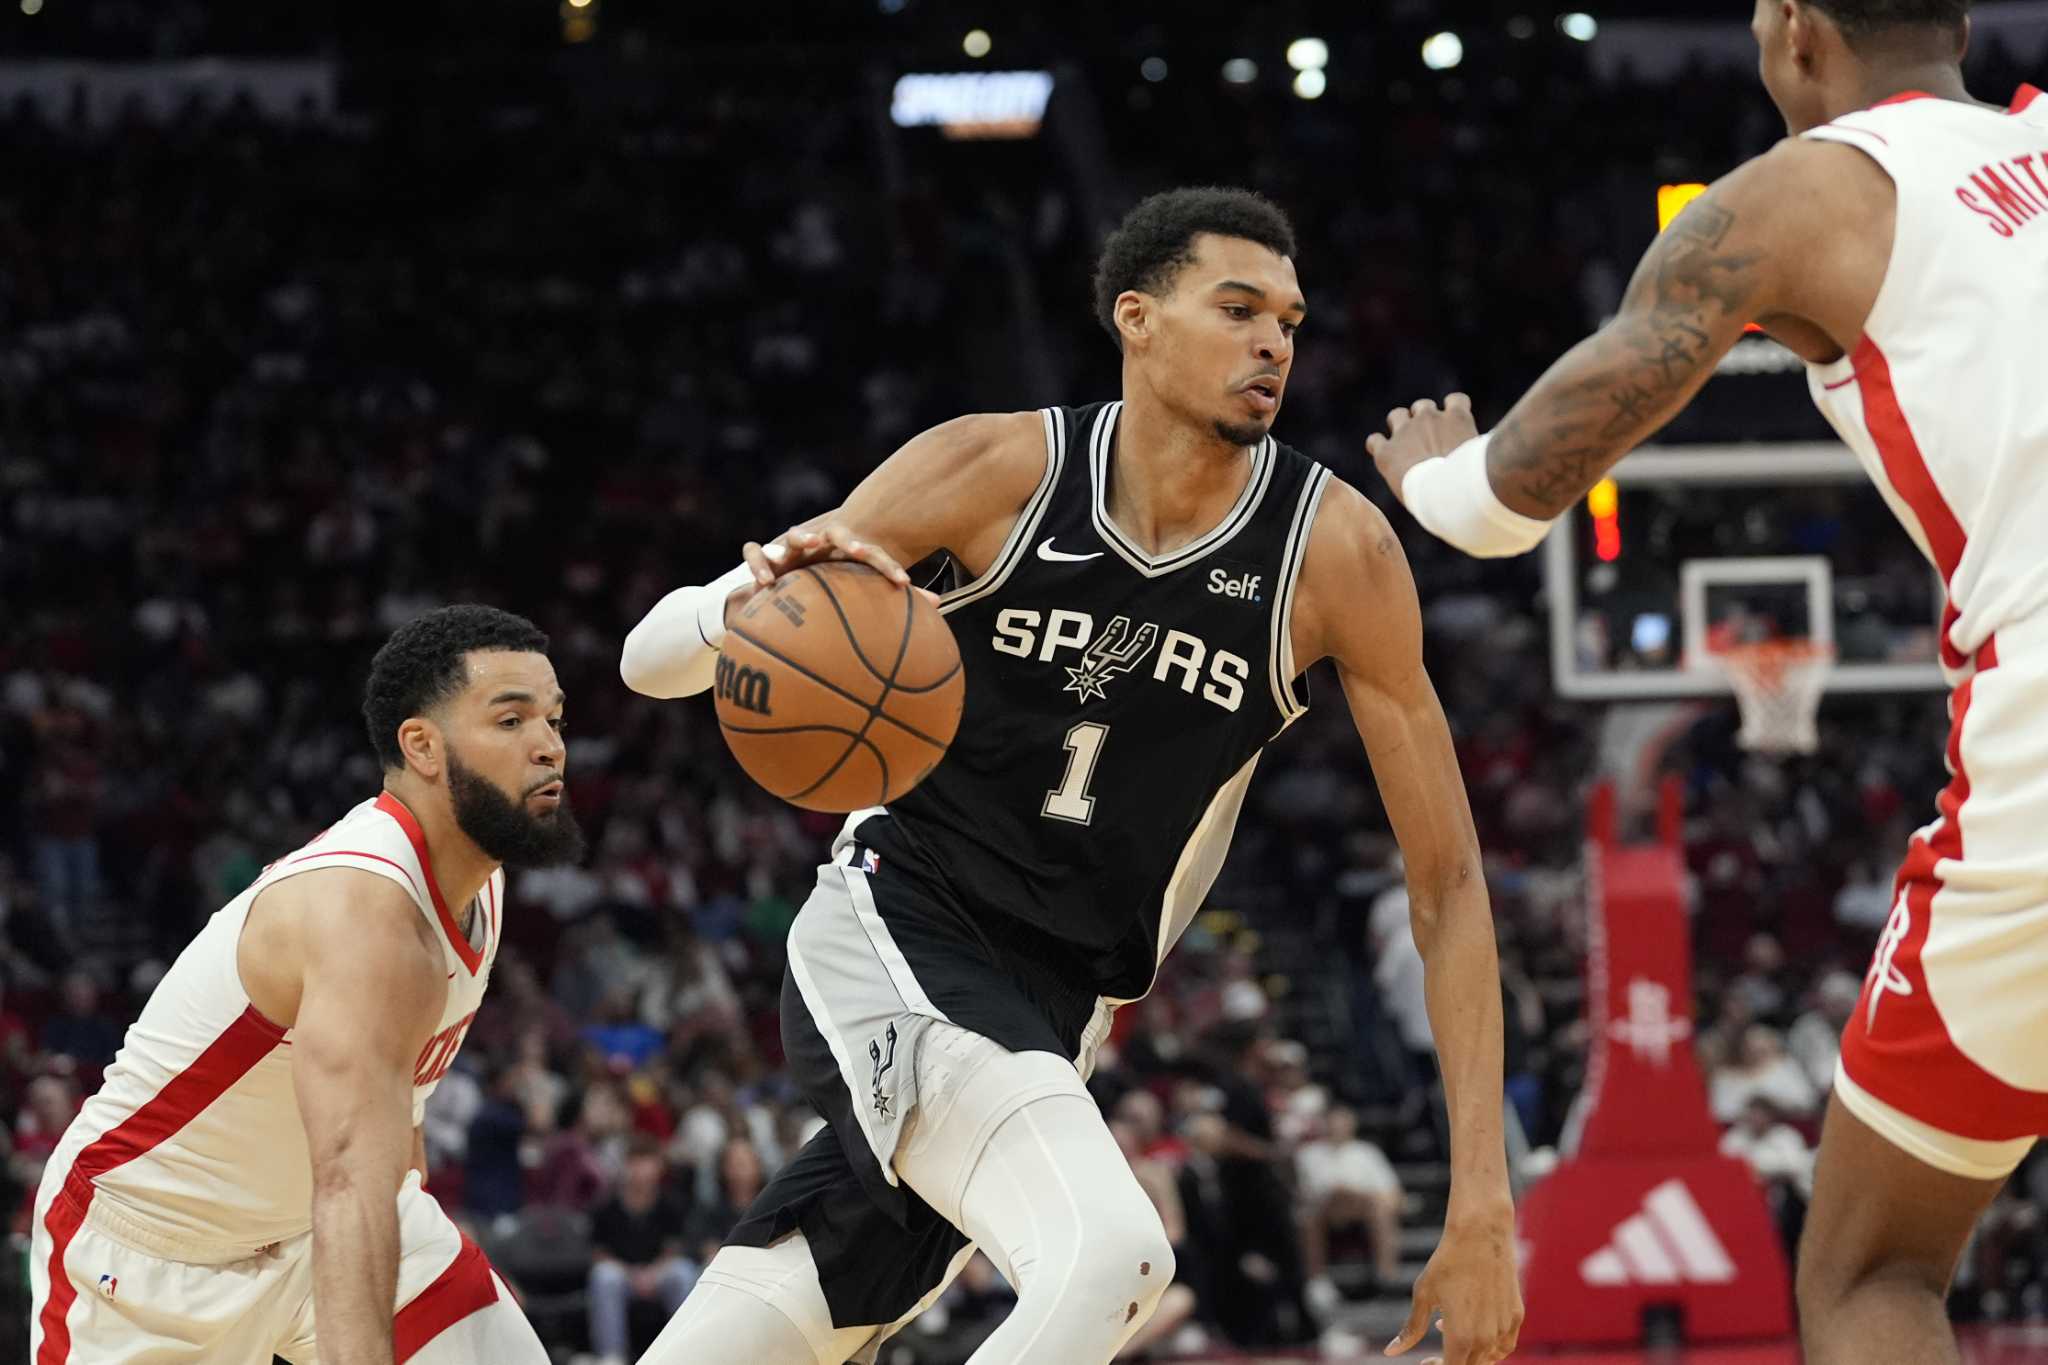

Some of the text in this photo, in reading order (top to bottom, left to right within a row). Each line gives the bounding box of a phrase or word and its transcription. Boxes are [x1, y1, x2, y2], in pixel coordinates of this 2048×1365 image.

[1955, 150, 2048, 238] SMIT
[991, 608, 1250, 713] SPURS
[1039, 720, 1111, 827] 1
